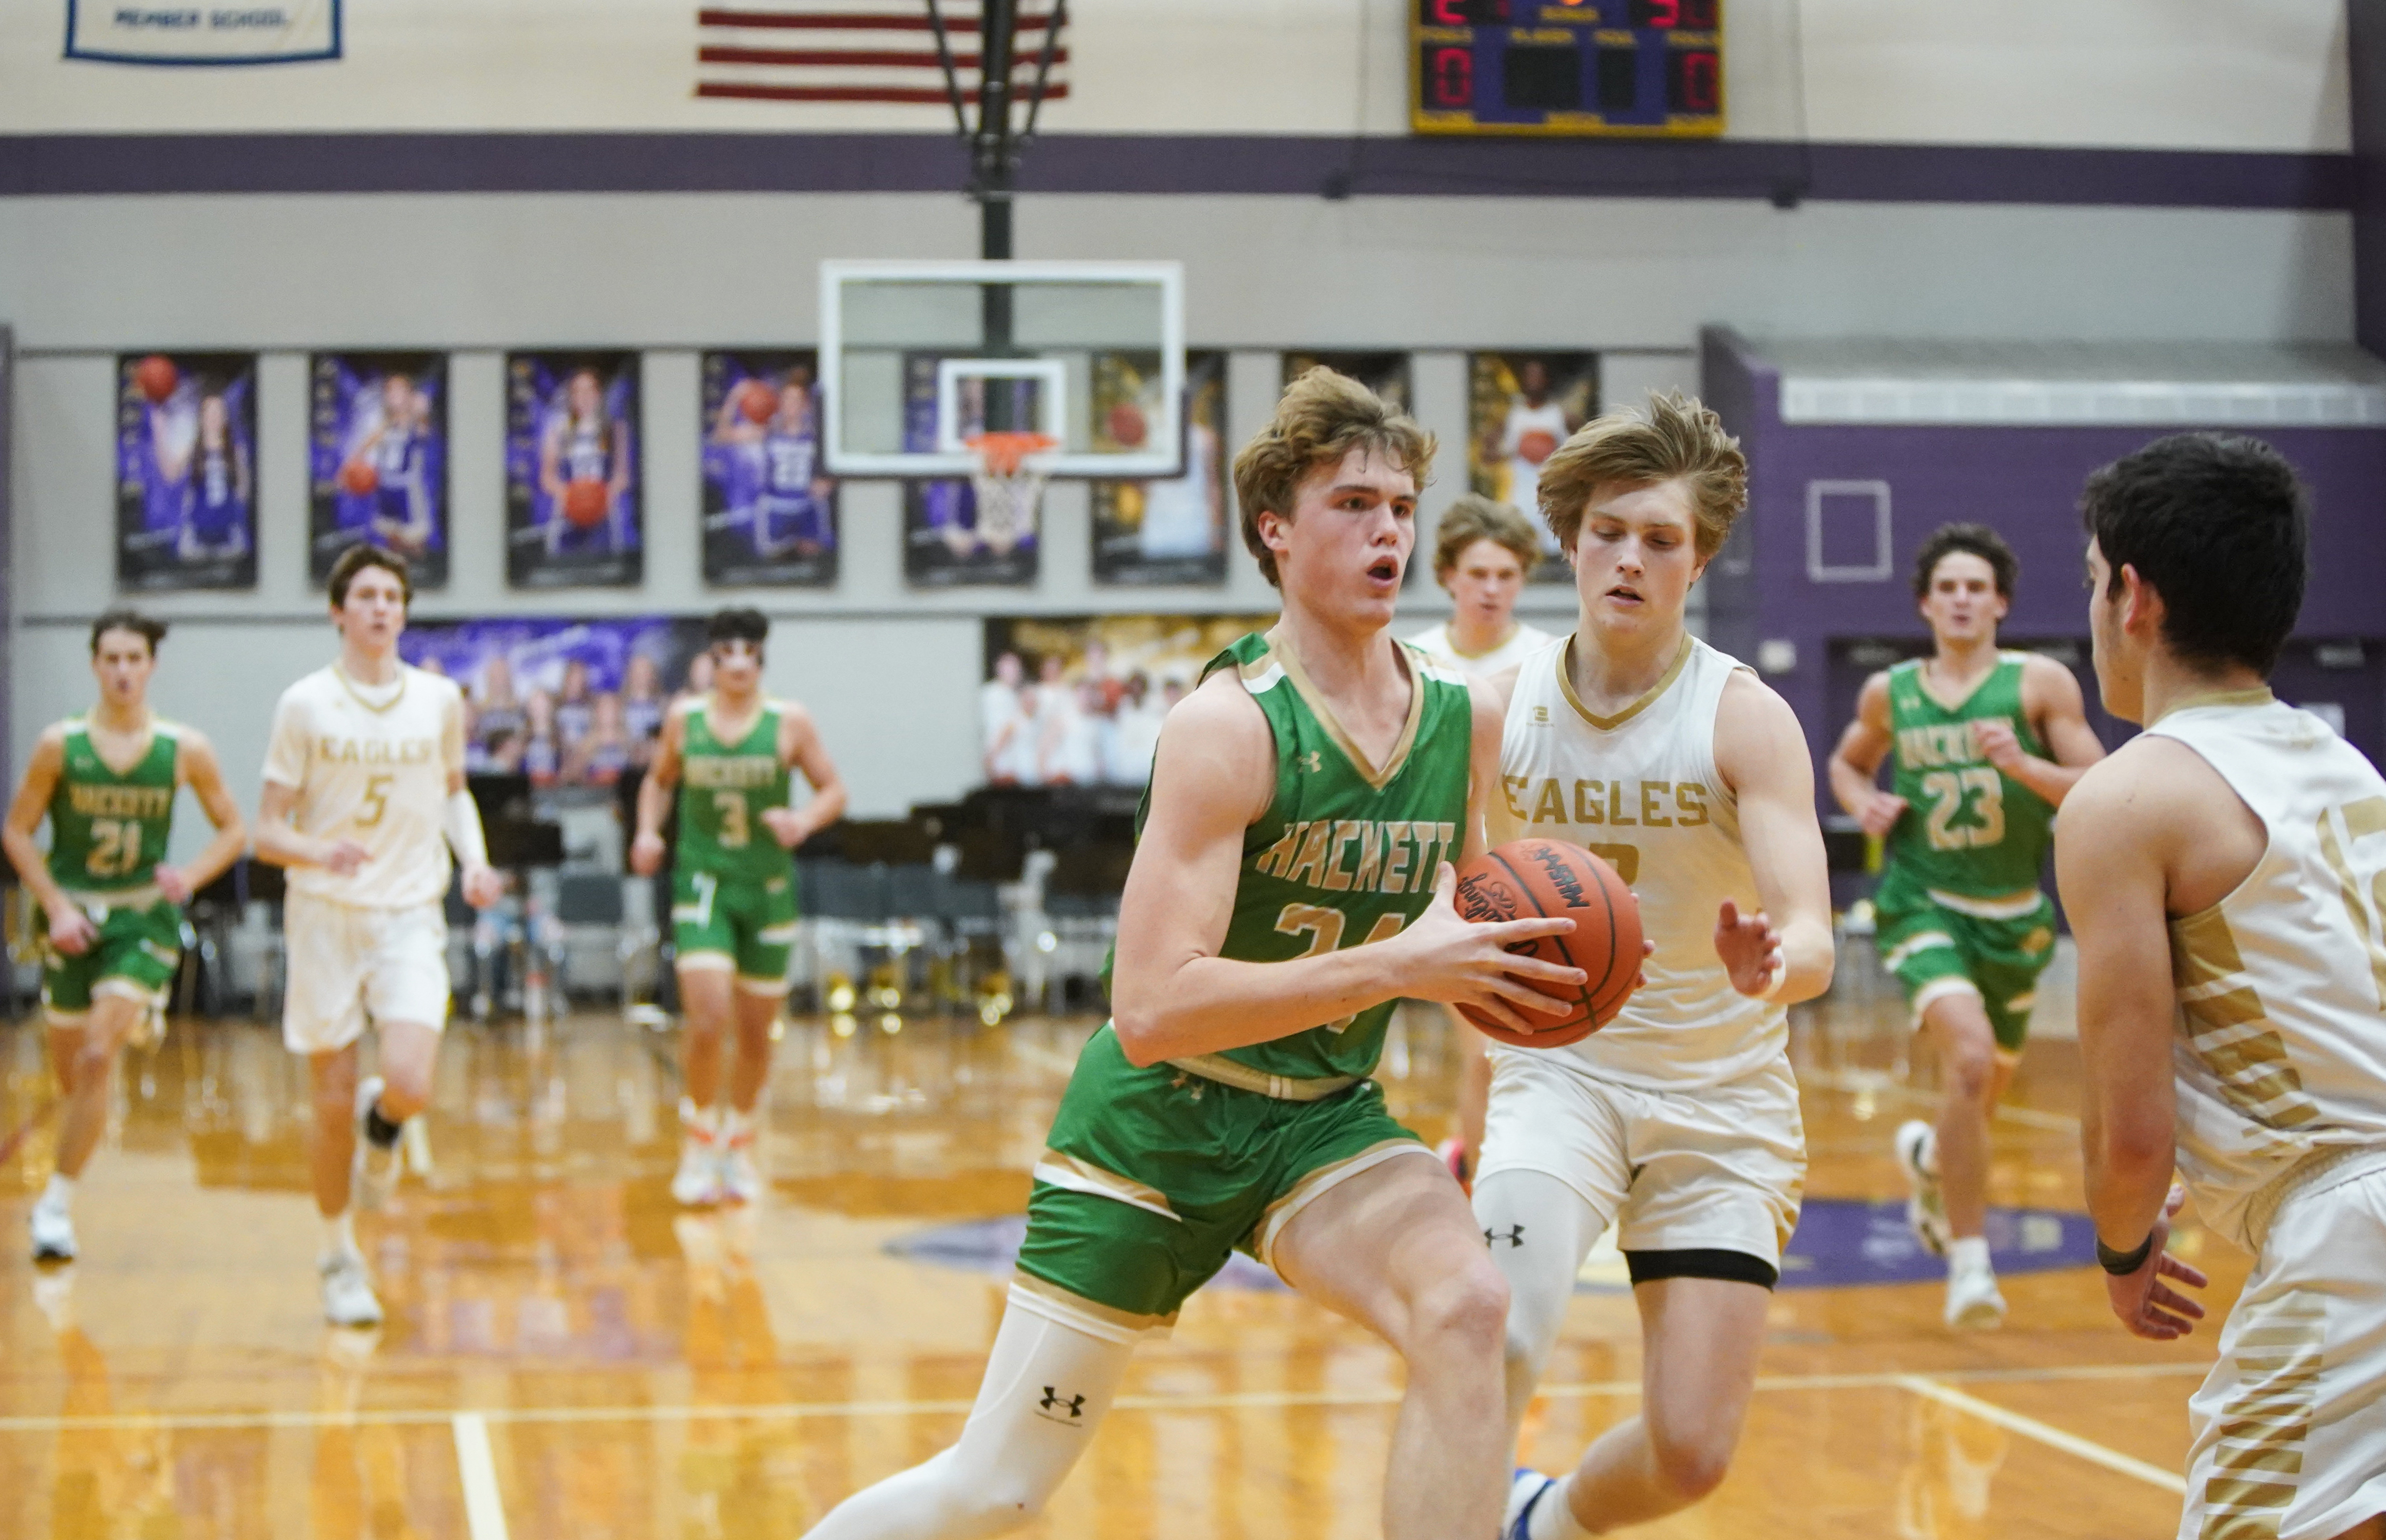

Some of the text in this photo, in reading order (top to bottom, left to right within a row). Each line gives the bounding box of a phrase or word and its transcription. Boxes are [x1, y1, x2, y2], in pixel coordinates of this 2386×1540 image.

[318, 737, 433, 766] EAGLES
[354, 775, 395, 828] 5
[713, 790, 750, 848] 3
[1502, 775, 1710, 828] EAGLES
[1922, 767, 2006, 851] 23
[86, 819, 143, 879] 21
[1255, 819, 1456, 894] HACKETT
